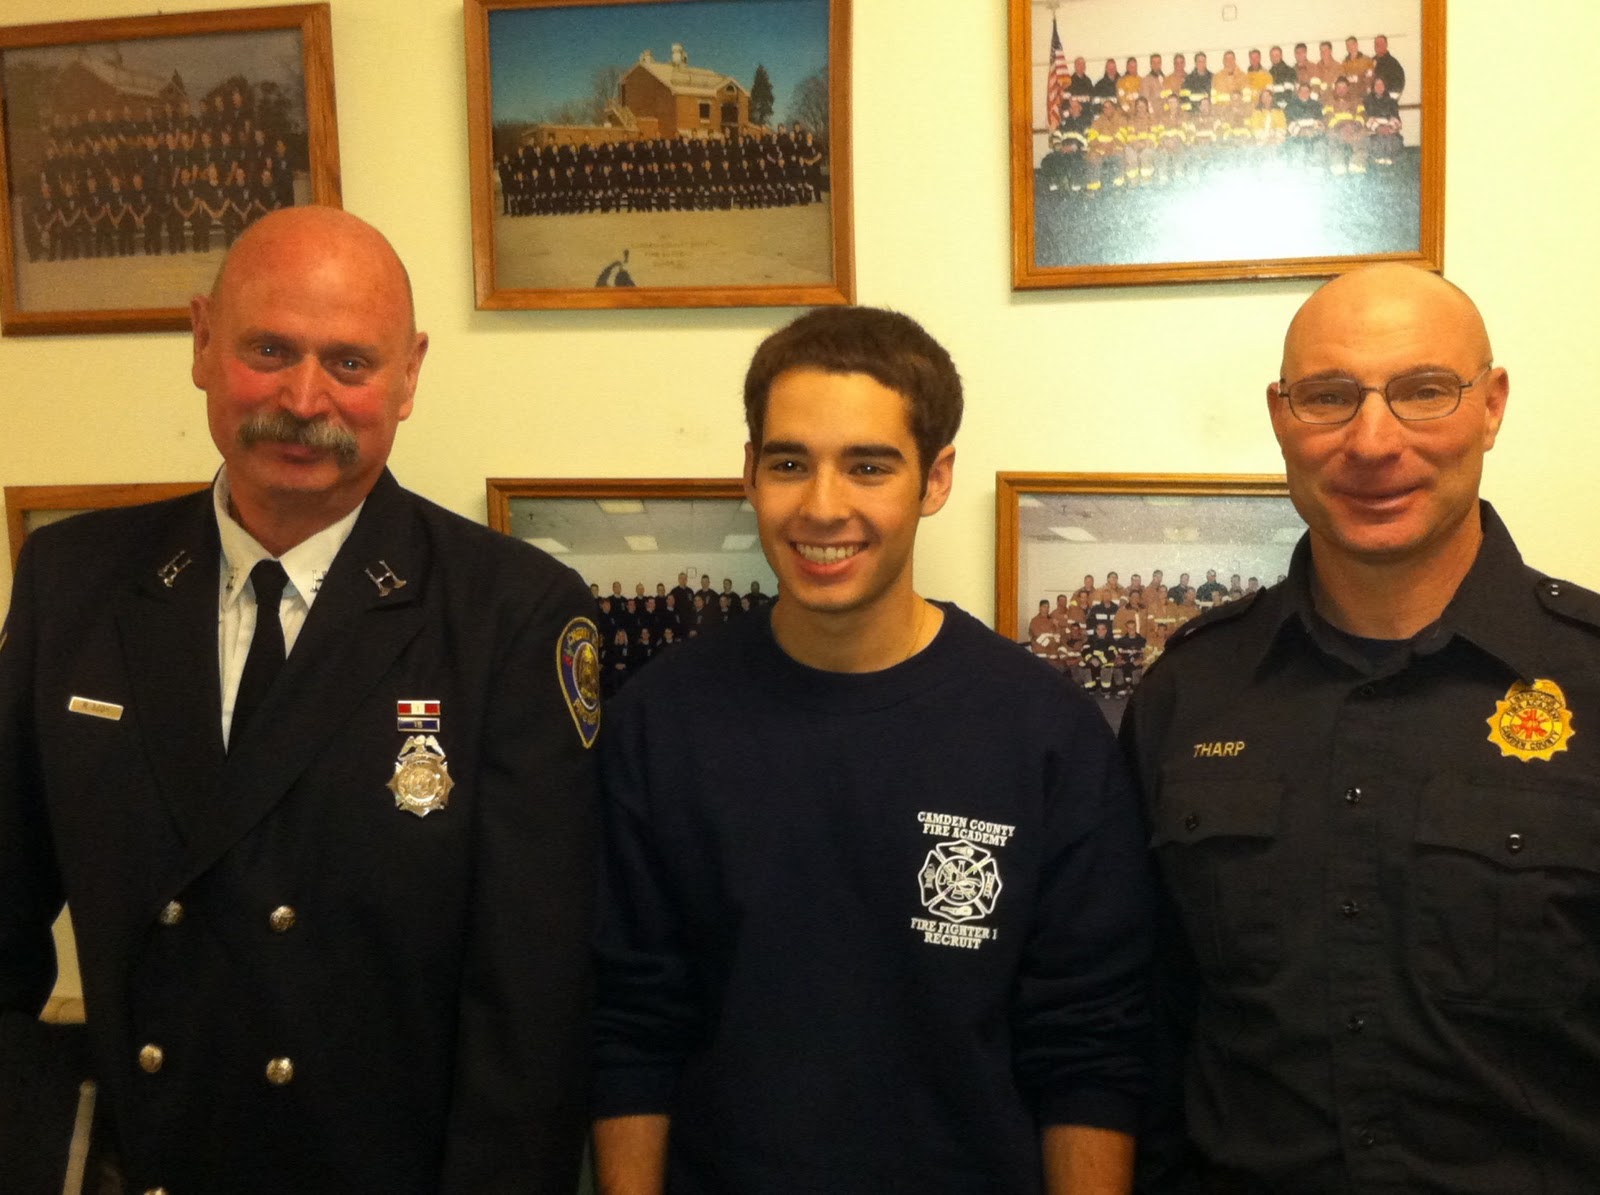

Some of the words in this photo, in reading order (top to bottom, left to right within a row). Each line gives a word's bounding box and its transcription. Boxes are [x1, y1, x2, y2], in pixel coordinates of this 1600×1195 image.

[1193, 741, 1246, 758] THARP
[1530, 730, 1560, 751] COUNTY
[917, 811, 968, 828] CAMDEN
[969, 819, 1016, 837] COUNTY
[922, 823, 950, 836] FIRE
[951, 828, 1008, 847] ACADEMY
[910, 917, 937, 932] FIRE
[937, 922, 990, 939] FIGHTER
[924, 931, 982, 949] RECRUIT
